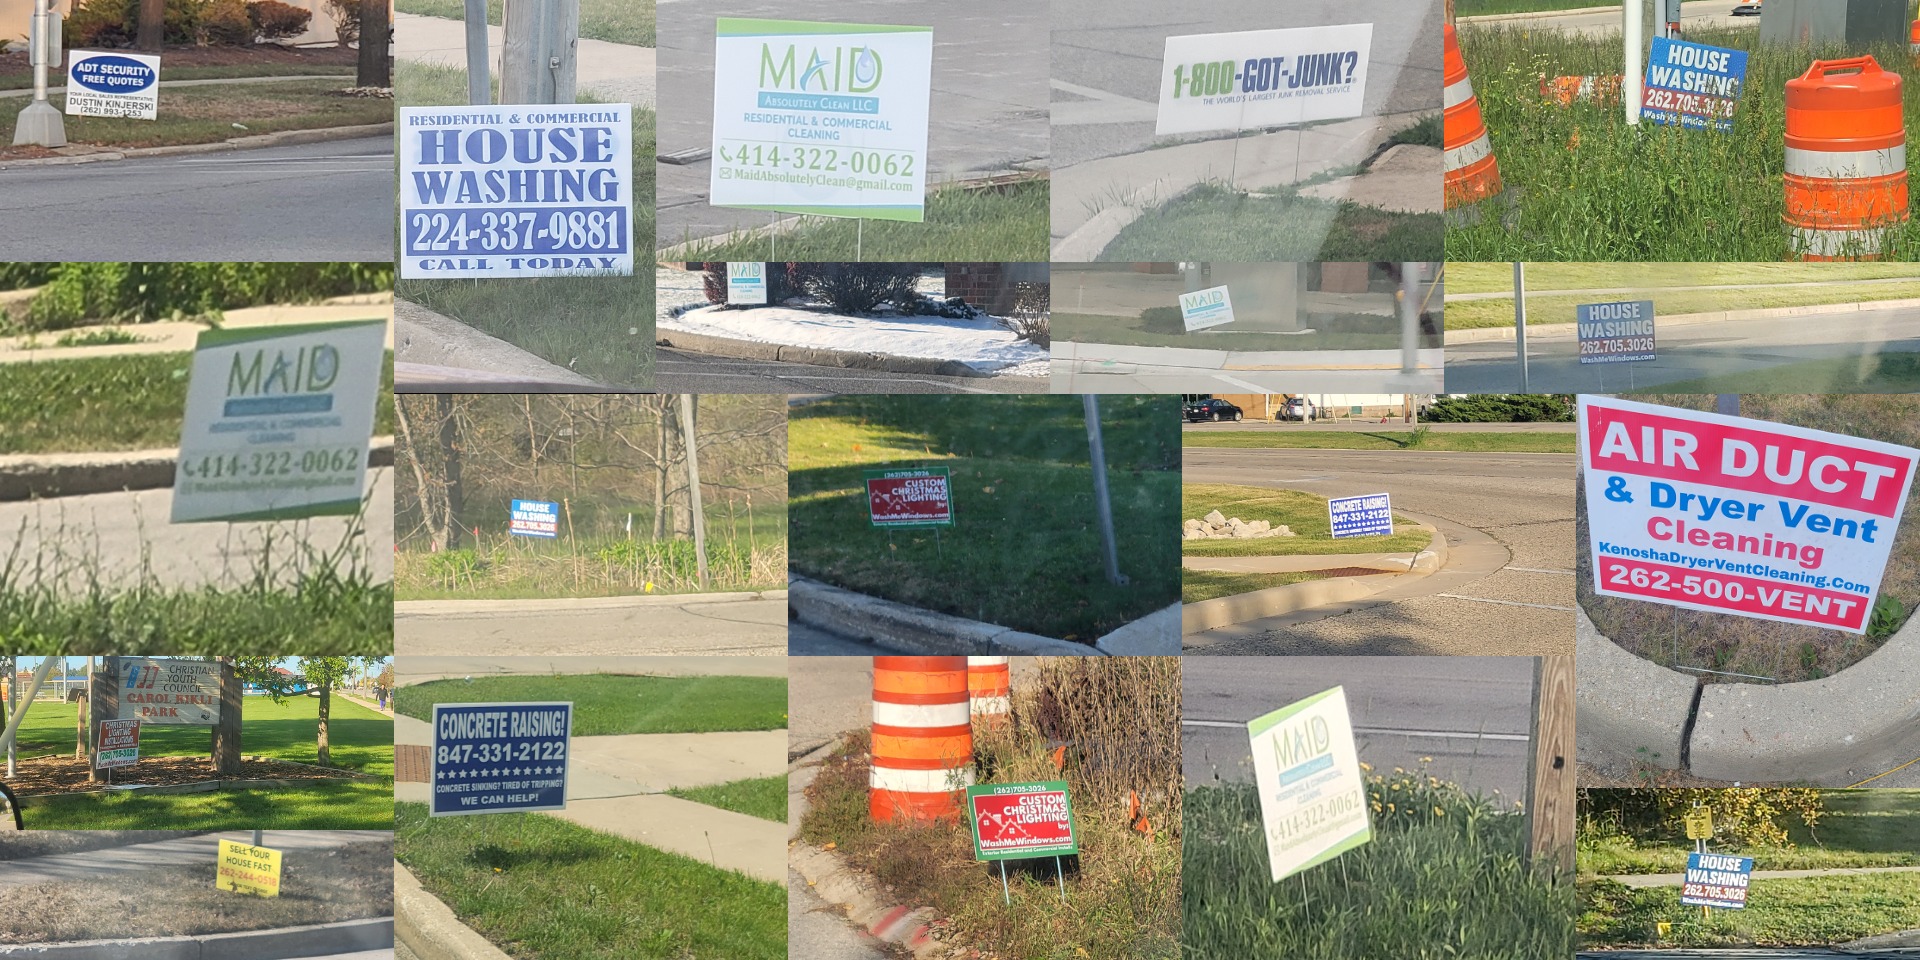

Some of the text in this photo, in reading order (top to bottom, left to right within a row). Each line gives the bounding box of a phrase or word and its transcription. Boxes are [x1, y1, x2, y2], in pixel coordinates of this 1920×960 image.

[1667, 44, 1730, 73] HOUSE
[77, 63, 151, 76] ADT SECURITY
[759, 42, 883, 93] MAID
[1173, 51, 1358, 99] 1-800-GOT-JUNK?
[82, 75, 144, 87] FREE QUOTES
[1203, 85, 1351, 105] THE WORLD'S LARGEST JUNK REMOVAL SERVICE
[70, 98, 154, 110] DUSTIN KINJERSKI
[852, 99, 873, 112] LLC
[104, 108, 142, 117] 993-1253
[409, 112, 621, 126] RESIDENTIAL & COMMERCIAL
[744, 113, 892, 131] RESIDENTIAL & COMMERCIAL
[787, 128, 840, 141] CLEANING
[418, 127, 613, 165] HOUSE
[736, 143, 914, 177] 414-322-0062
[411, 168, 619, 205] WASHING
[734, 168, 913, 192] MaidAbsolutelyClean@gmail.com
[412, 211, 619, 251] 224-337-9881
[419, 257, 617, 271] CALL TODAY
[731, 262, 760, 277] MAID
[1185, 290, 1223, 309] MAID
[1589, 303, 1640, 320] HOUSE
[1579, 320, 1653, 338] WASHING
[1581, 338, 1654, 354] 262.705.3026
[227, 344, 340, 396] MAID
[197, 447, 360, 478] 414-322-0062
[1598, 421, 1897, 501] AIR DUCT
[905, 479, 946, 487] CUSTOM
[892, 487, 946, 495] CHRISTMAS
[903, 494, 947, 502] LIGHTING
[520, 502, 550, 513] HOUSE
[1604, 476, 1879, 544] & Dryer Vent
[513, 511, 556, 523] WASHING
[872, 512, 949, 520] WashMeWindows.com
[1333, 509, 1388, 523] 847-331-2122
[1646, 516, 1825, 570] Cleaning
[1599, 541, 1871, 595] KenoshaDryerVentCleaning.Com
[1608, 564, 1857, 620] 262-500-VENT
[169, 665, 215, 675] CHRISTIAN
[167, 674, 197, 684] YOUTH
[163, 683, 201, 693] COUNCIL
[127, 693, 171, 704] CAROL
[142, 706, 179, 717] PARK
[105, 720, 138, 730] CHRISTMAS
[108, 728, 132, 737] LIGHTING
[440, 710, 566, 740] CONCRETE RAISING!
[1272, 715, 1330, 771] MAID
[437, 742, 565, 765] 847-331-2122
[436, 779, 563, 794] CONCRETE SINKING? TIRED OF TRIPPING?
[993, 785, 1046, 795] (262)705-3026
[461, 793, 539, 805] WE CAN HELP!
[1019, 794, 1066, 806] CUSTOM
[1003, 803, 1067, 816] CHRISTMAS
[1278, 790, 1360, 841] 414-322-0062
[1016, 812, 1068, 824] LIGHTING
[981, 836, 1071, 848] WashMeWindows.com
[230, 845, 270, 860] SELL YOUR
[226, 856, 272, 872] HOUSE FAST
[1699, 855, 1742, 871] HOUSE
[220, 867, 277, 887] 262-244-0518
[1687, 869, 1749, 887] WASHING
[1684, 884, 1746, 900] 262.705.3026
